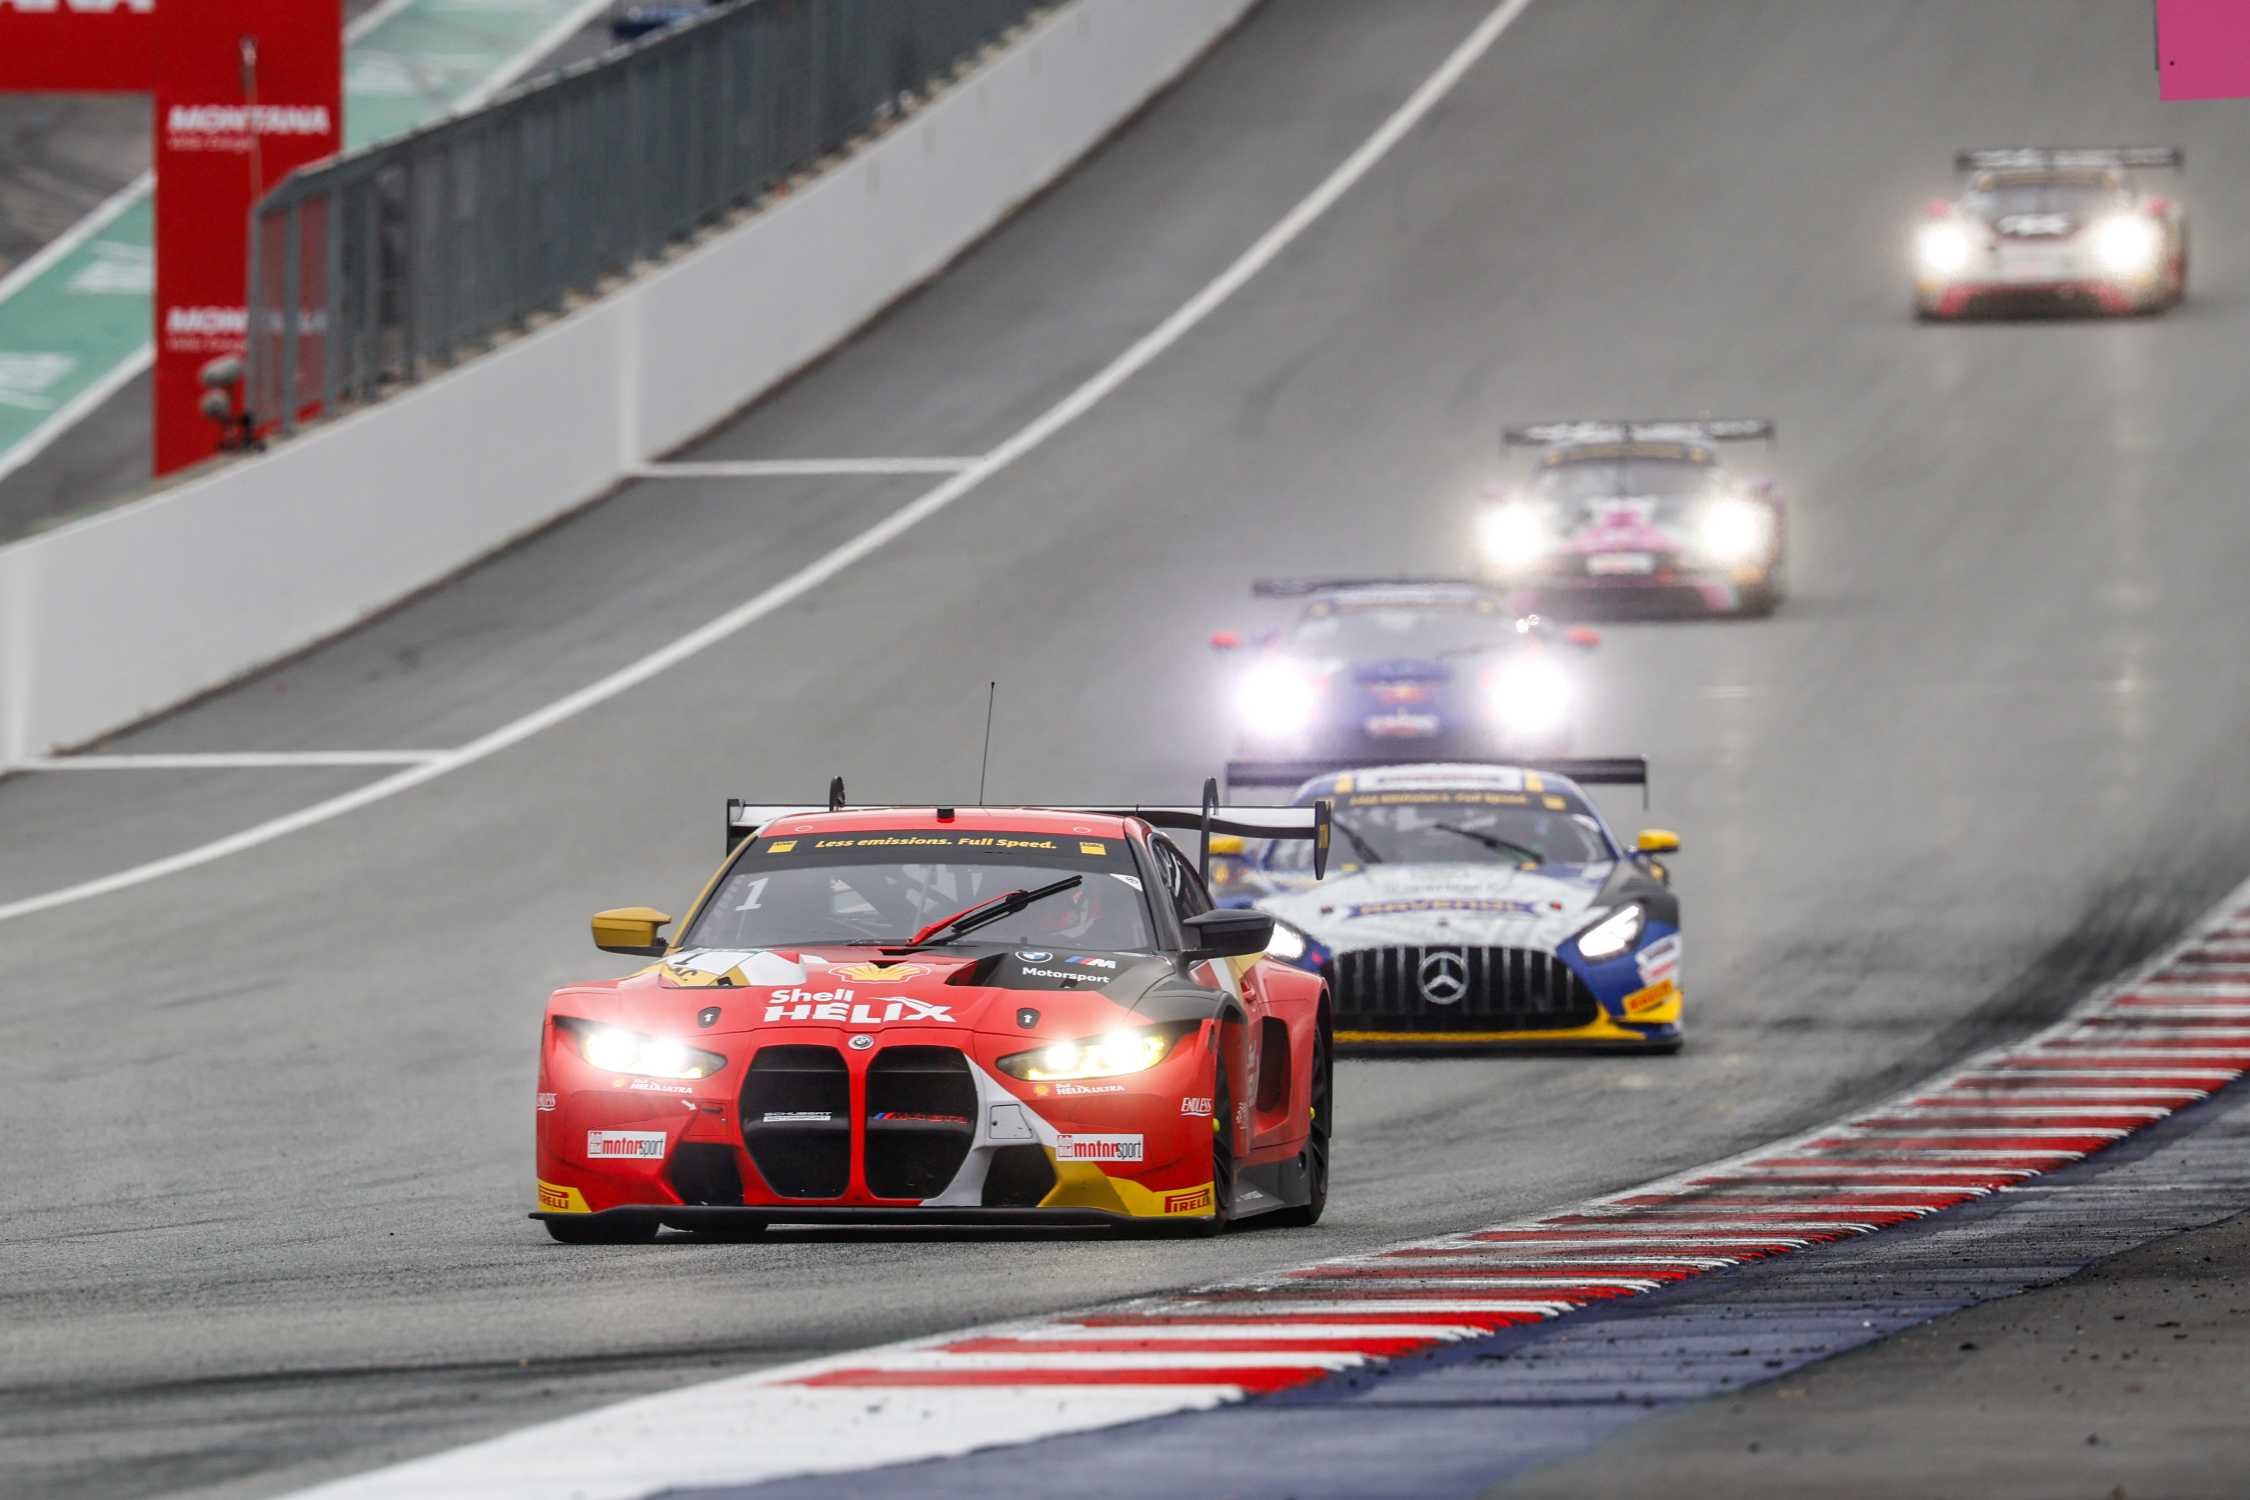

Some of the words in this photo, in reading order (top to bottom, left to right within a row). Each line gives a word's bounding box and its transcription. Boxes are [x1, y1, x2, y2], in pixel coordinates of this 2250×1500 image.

[170, 105, 331, 135] MONTANA
[815, 839, 854, 849] Less
[857, 836, 952, 846] emissions.
[958, 837, 993, 846] Full
[996, 838, 1057, 849] Speed.
[736, 877, 768, 911] 1
[1022, 966, 1111, 983] Motorsport
[769, 988, 855, 1004] Shell
[763, 996, 957, 1024] HELIX
[603, 1137, 665, 1157] motorsport
[1073, 1139, 1142, 1160] motorsport
